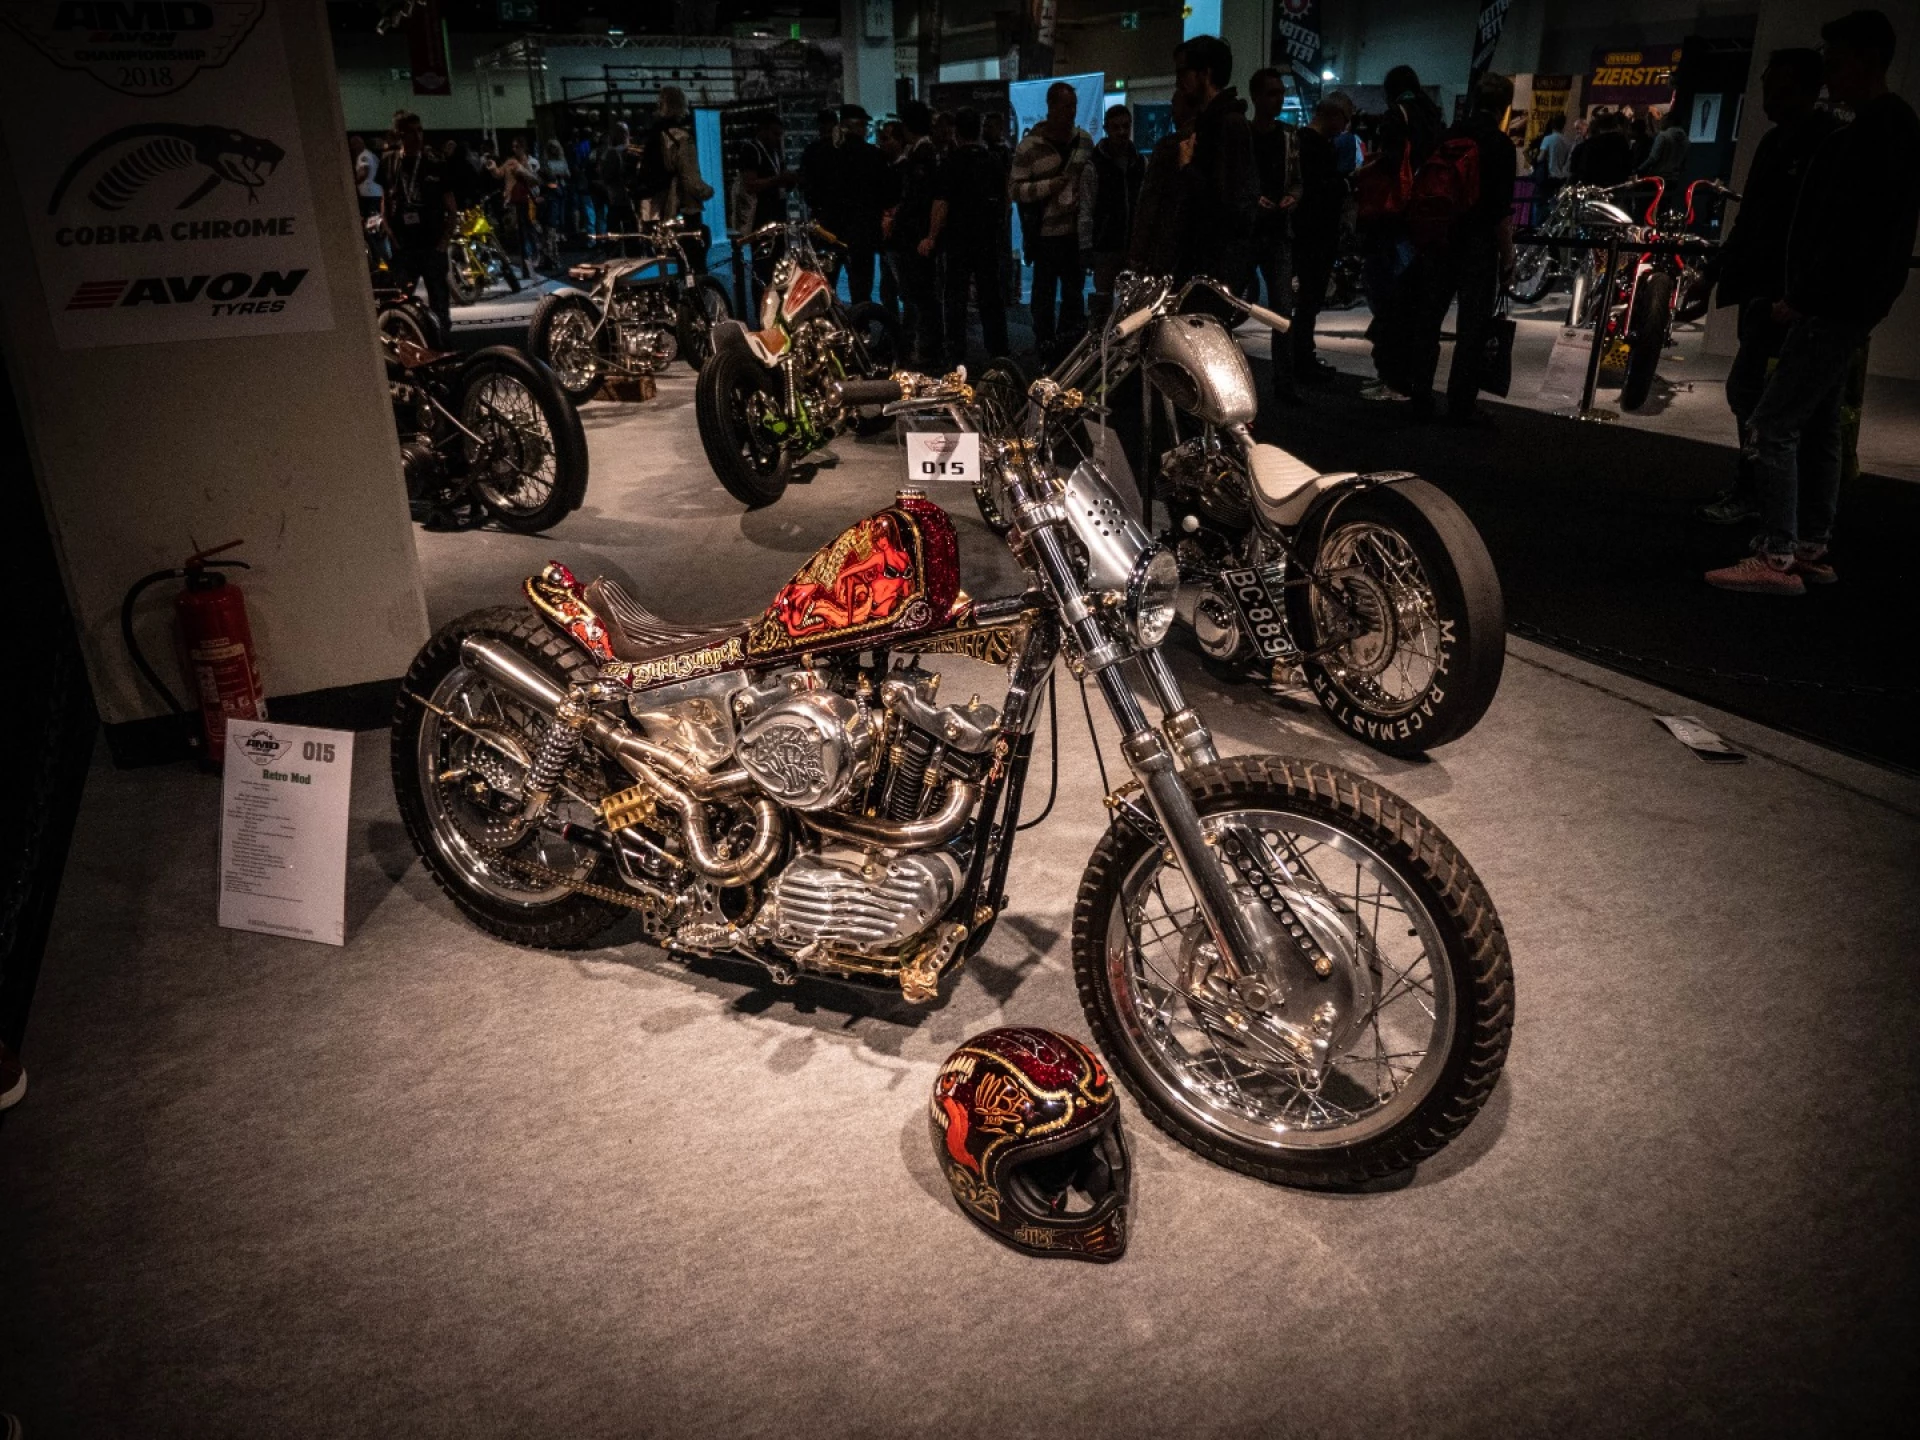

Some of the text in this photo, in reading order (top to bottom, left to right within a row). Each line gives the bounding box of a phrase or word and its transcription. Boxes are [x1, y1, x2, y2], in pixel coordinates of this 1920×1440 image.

[53, 0, 214, 30] AMD
[74, 50, 206, 61] CHAMPIONSHIP
[118, 66, 174, 87] 2018
[55, 216, 296, 247] COBRA CHROME
[119, 268, 310, 307] AVON
[210, 300, 286, 317] TYRES
[922, 461, 965, 475] 015
[1313, 673, 1446, 741] RACEMASTER
[302, 740, 336, 763] 015
[263, 769, 311, 784] Retro Mod
